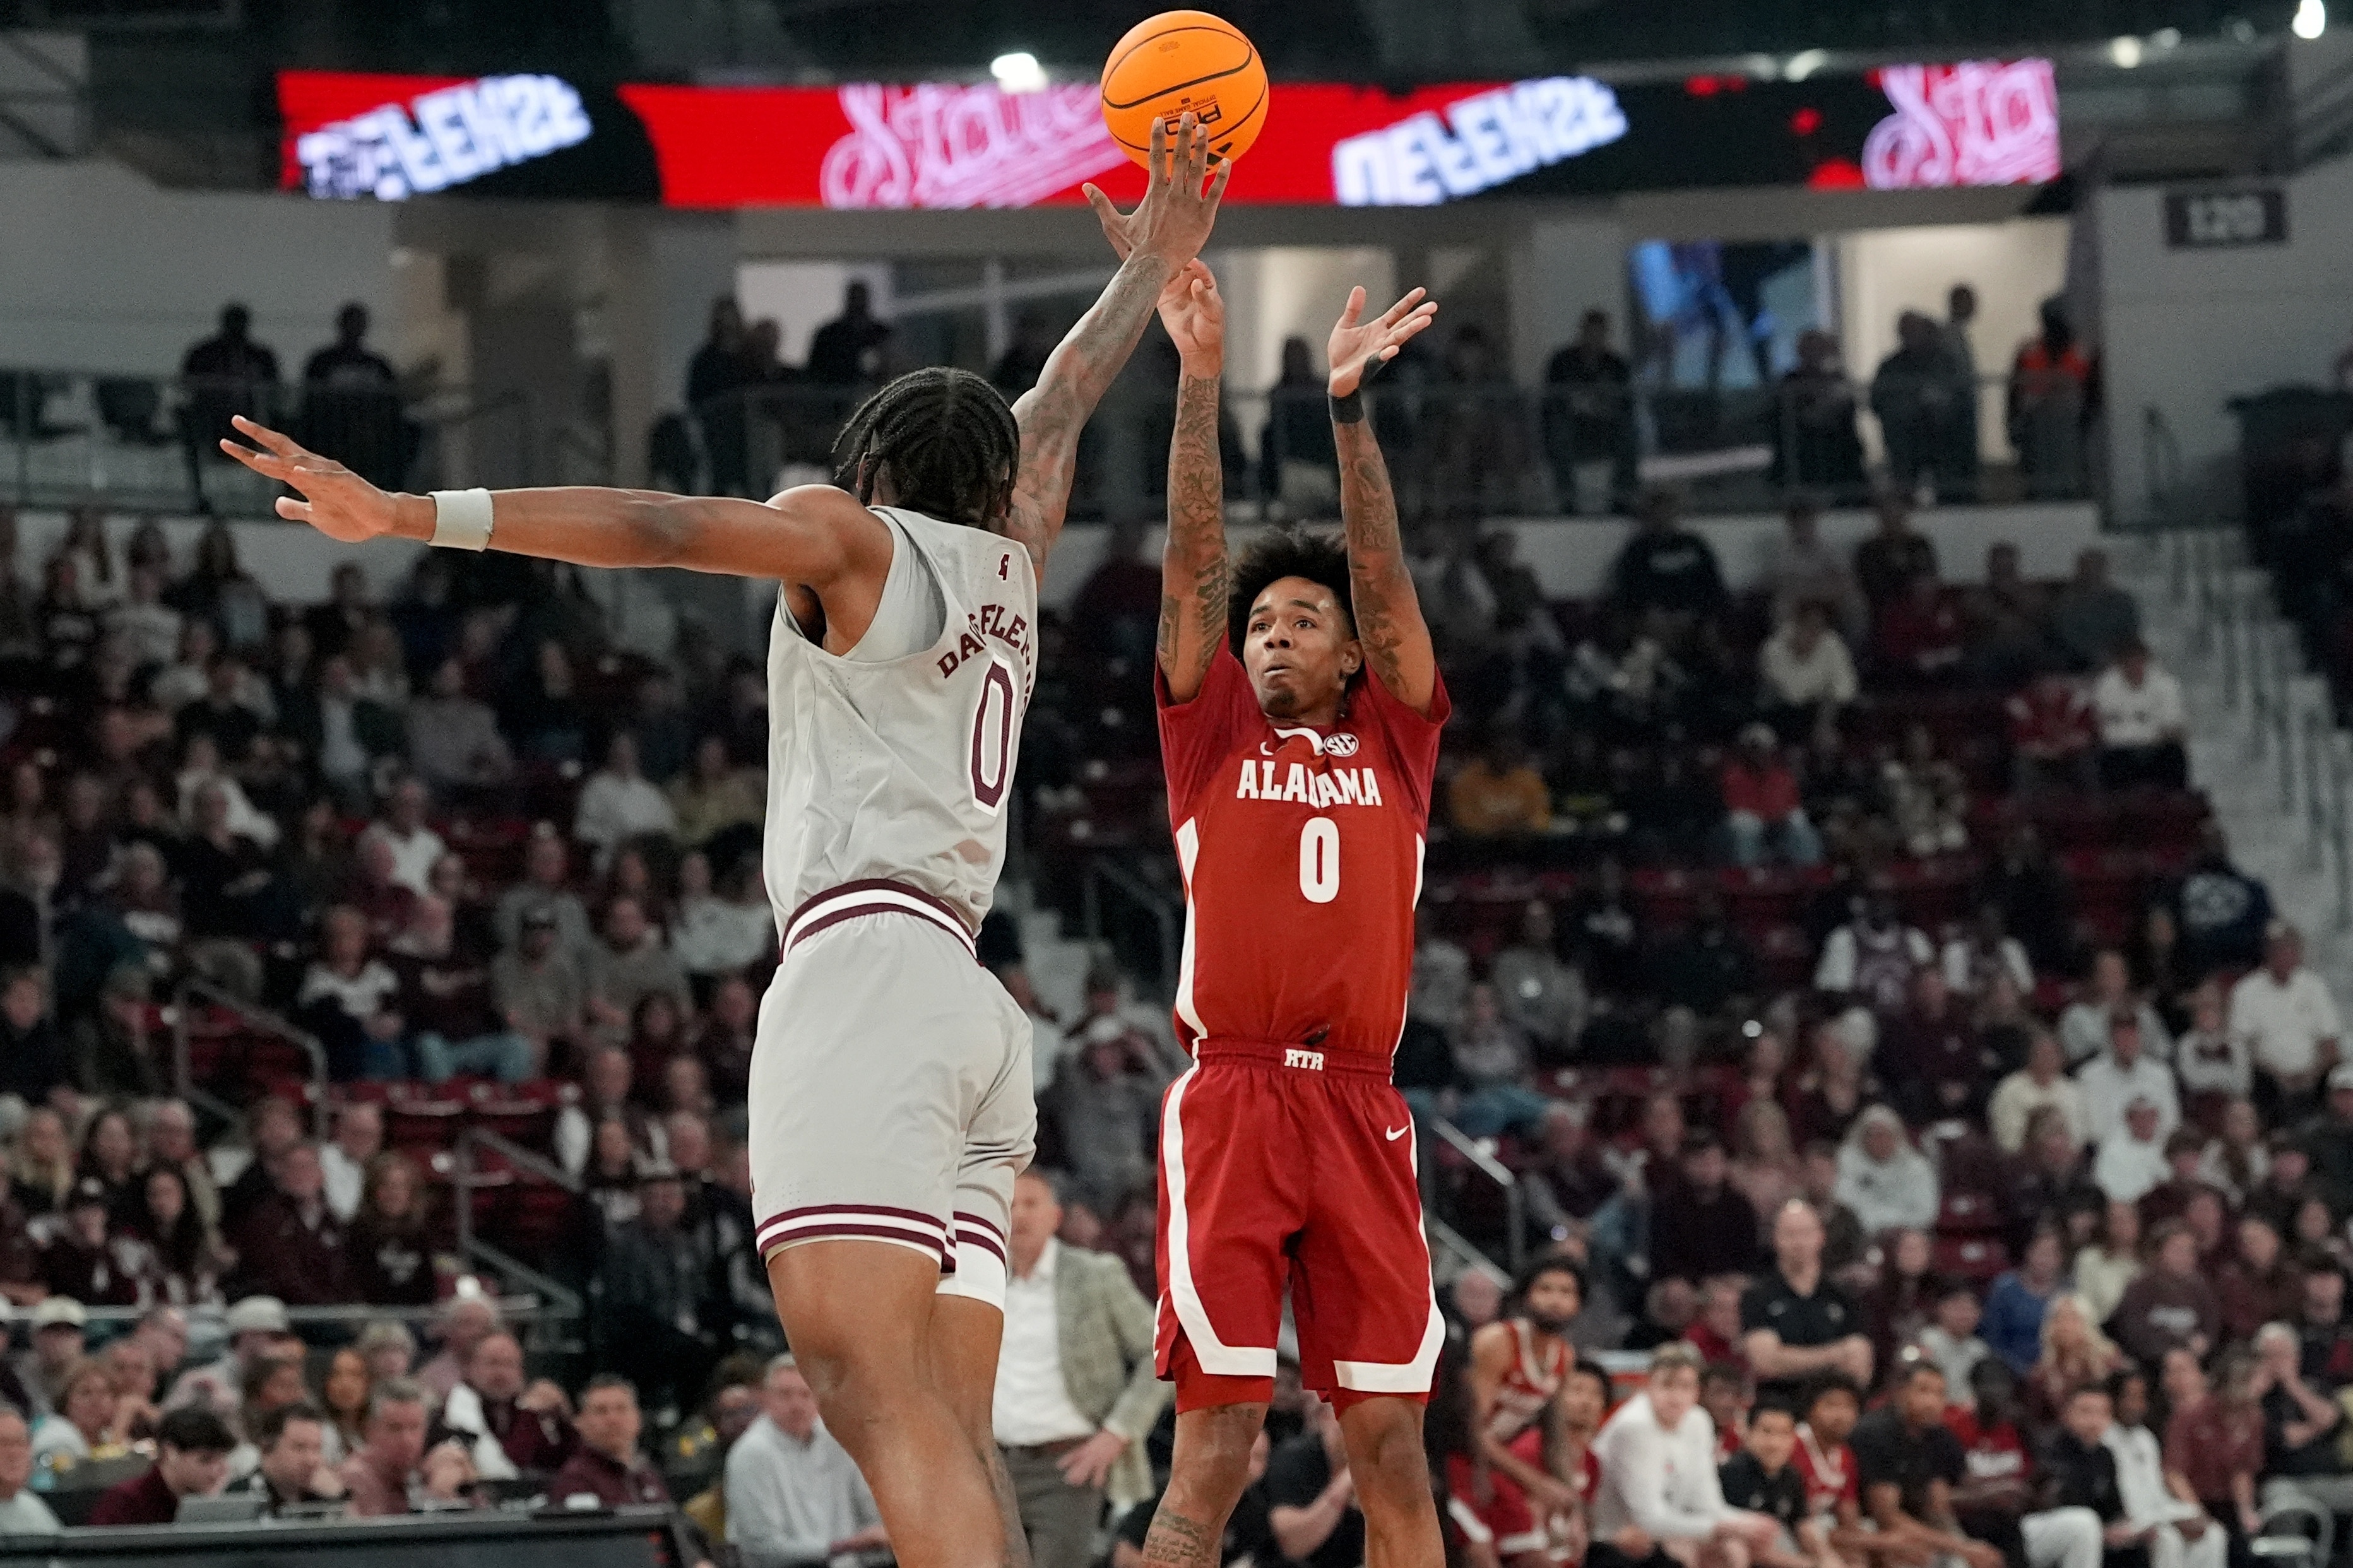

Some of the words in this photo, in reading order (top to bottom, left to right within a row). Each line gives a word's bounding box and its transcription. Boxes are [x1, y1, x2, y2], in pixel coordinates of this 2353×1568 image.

[969, 654, 1017, 816] 0
[1325, 733, 1358, 756] SEC
[1236, 759, 1383, 809] ALABAMA
[1300, 816, 1340, 904] 0
[1284, 1048, 1325, 1071] RTR
